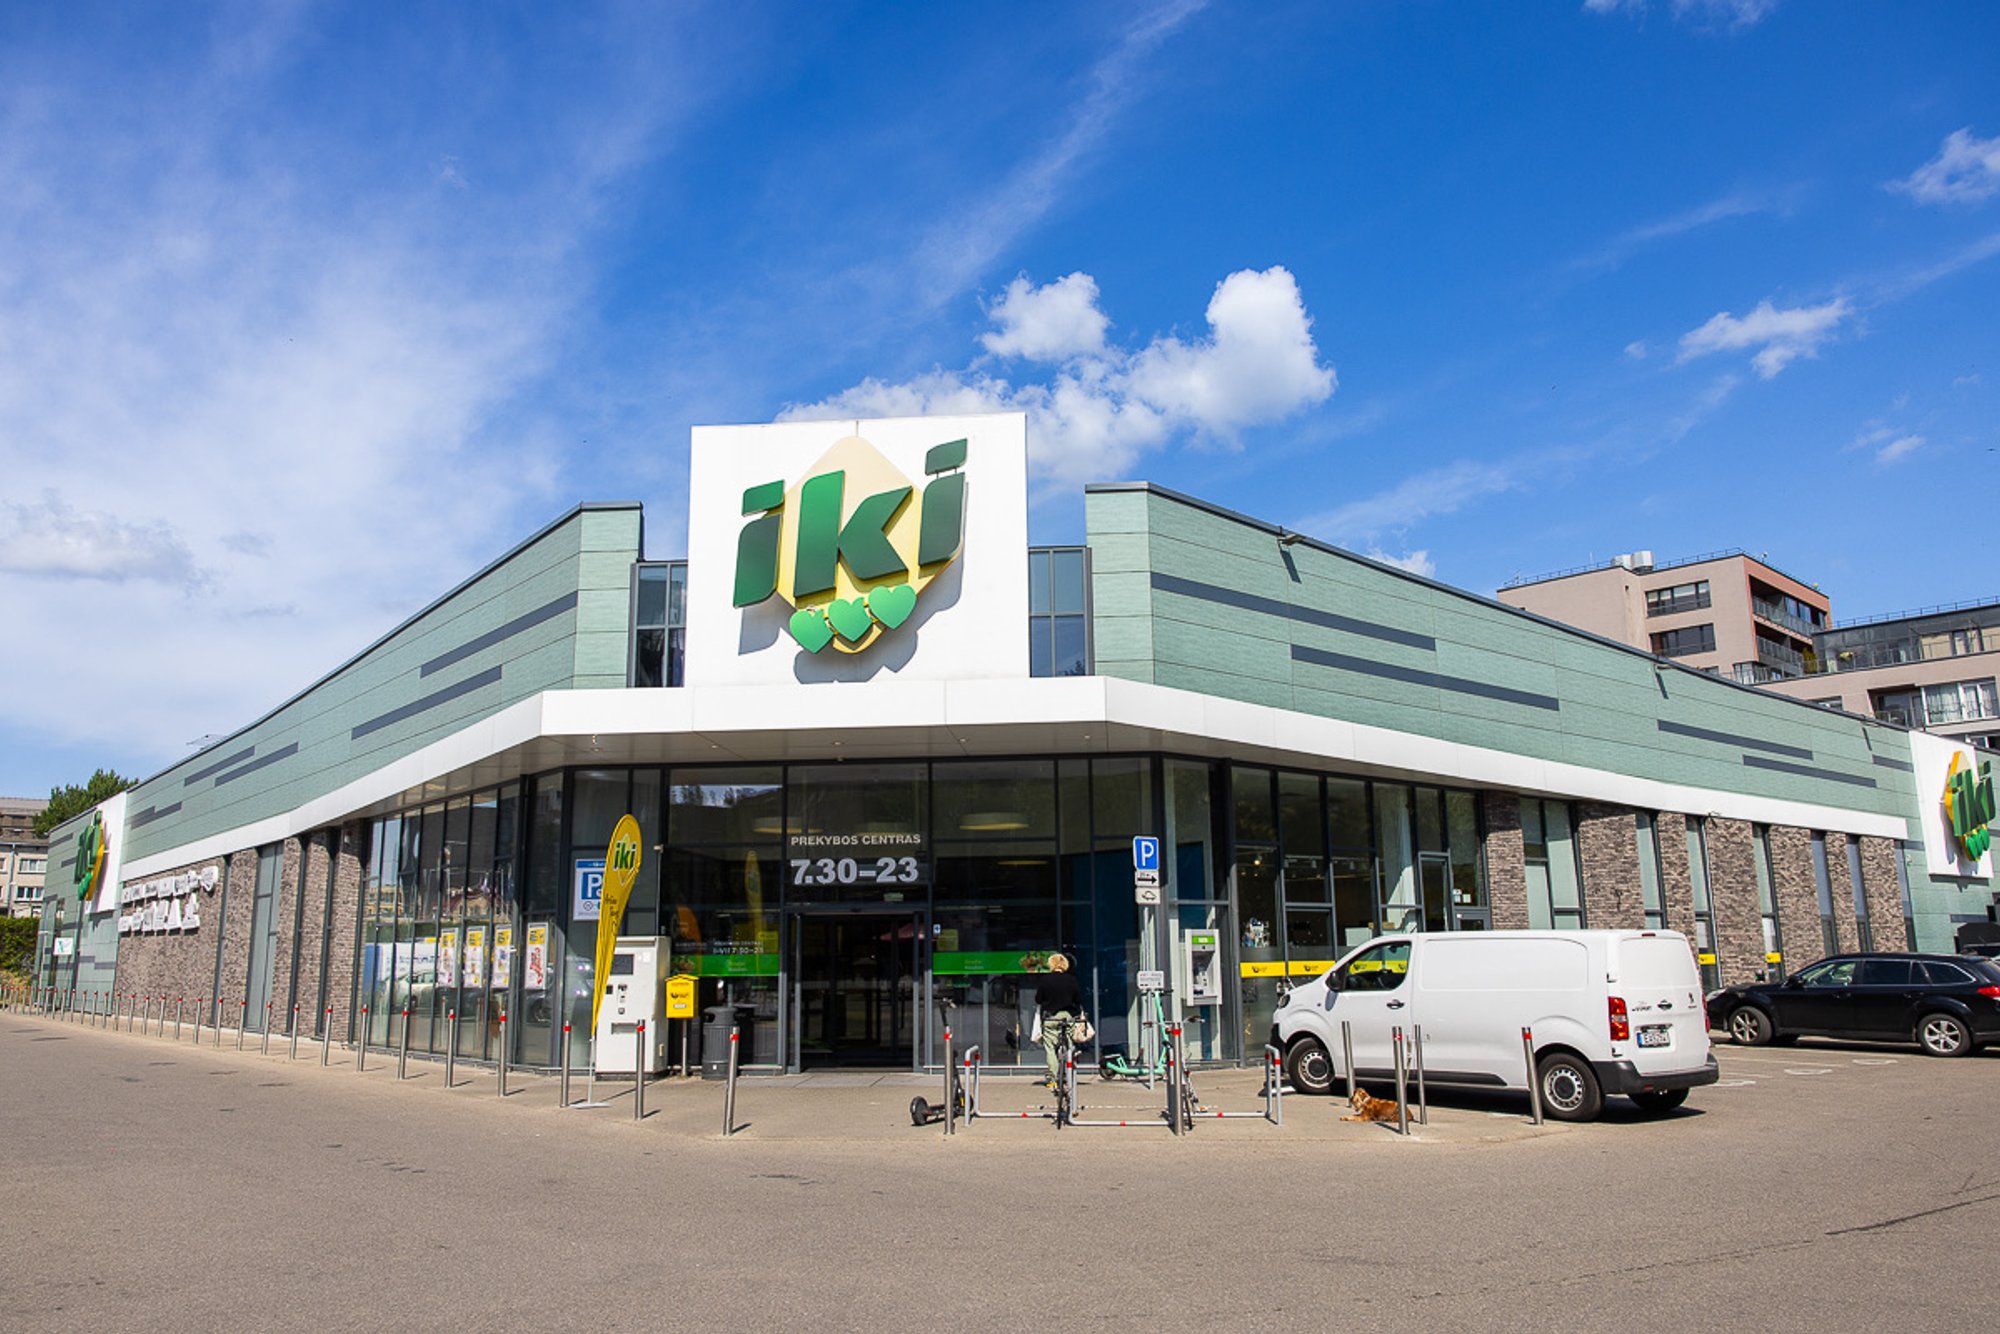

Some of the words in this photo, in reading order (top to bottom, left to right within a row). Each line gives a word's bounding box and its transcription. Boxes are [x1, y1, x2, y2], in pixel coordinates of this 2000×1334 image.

[733, 438, 968, 608] iki
[791, 835, 859, 846] PREKYBOS
[862, 833, 921, 846] CENTRAS
[1141, 841, 1154, 867] P
[613, 841, 637, 870] iki
[790, 856, 919, 886] 7.30-23
